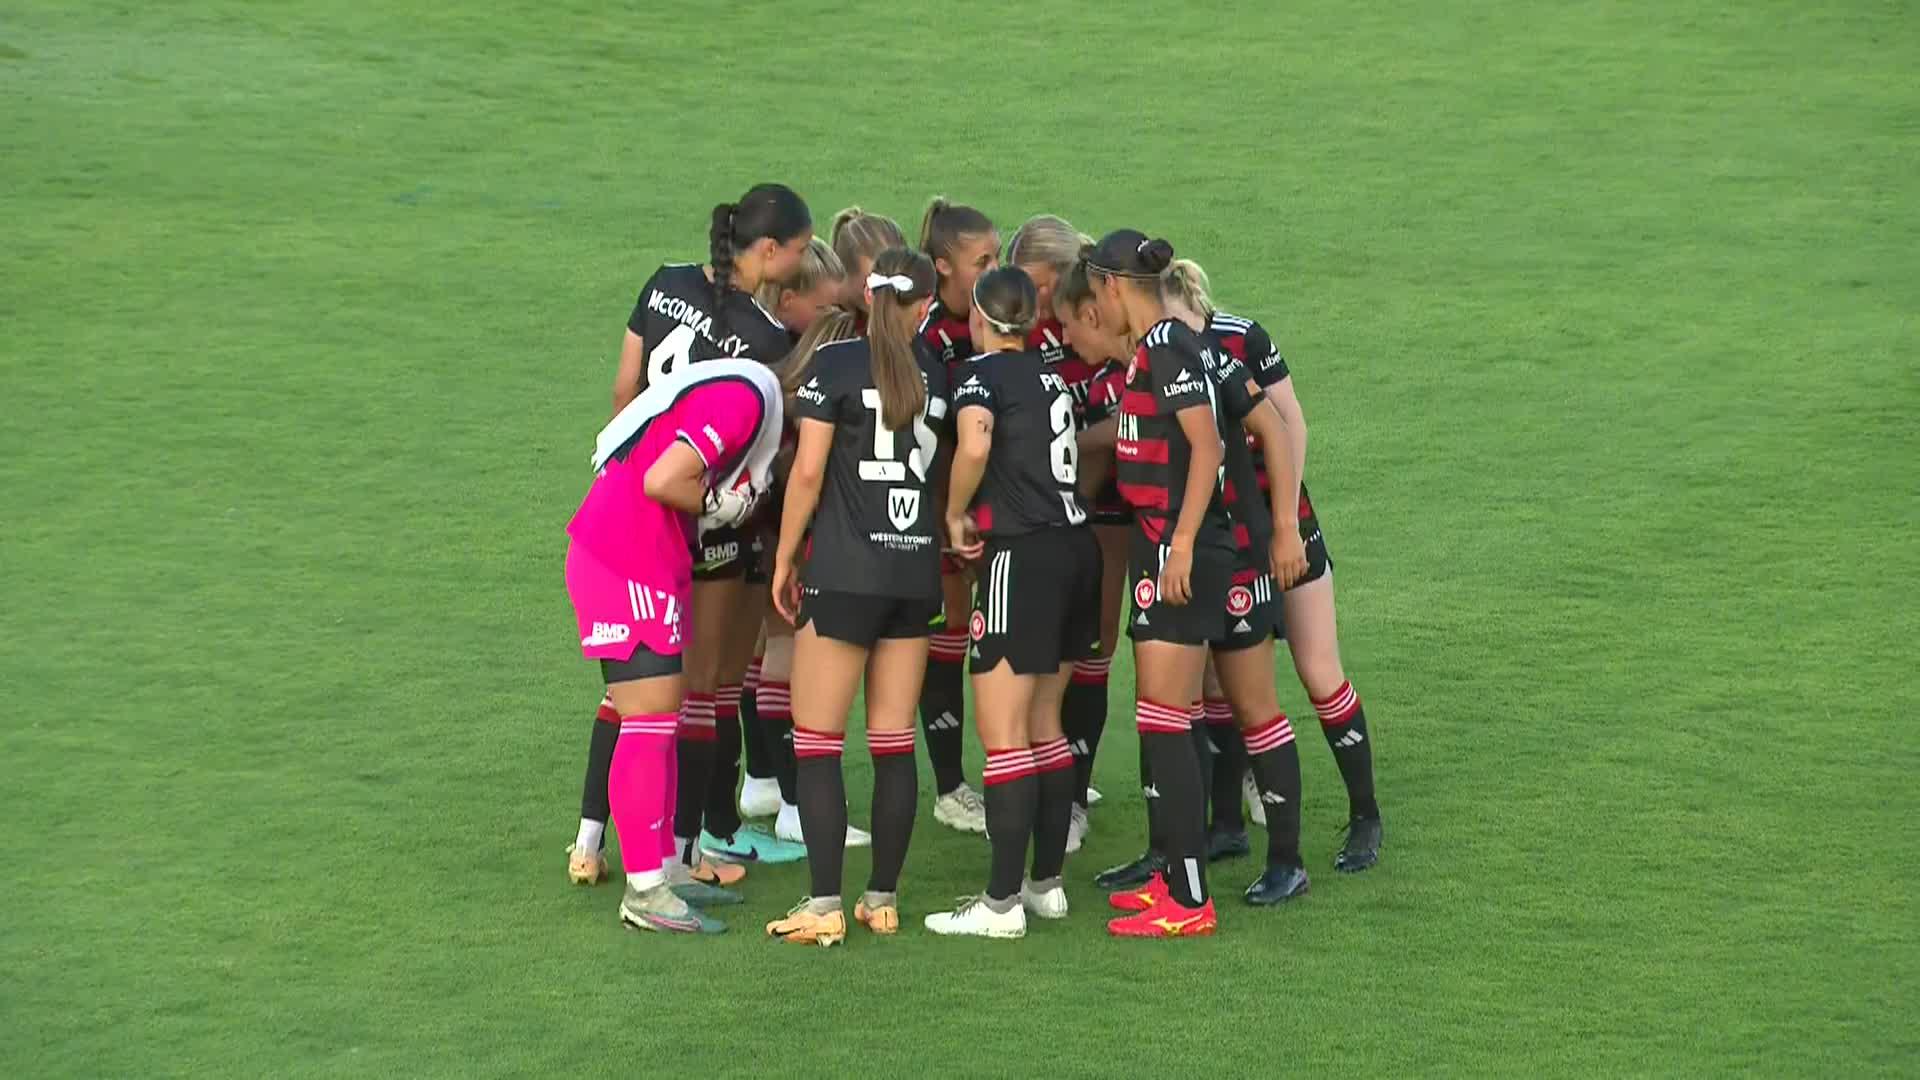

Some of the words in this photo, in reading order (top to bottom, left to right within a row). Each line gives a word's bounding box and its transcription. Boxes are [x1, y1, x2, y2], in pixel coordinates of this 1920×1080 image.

[647, 288, 750, 358] McCOMAKY
[1163, 380, 1204, 398] Liberty
[892, 495, 915, 519] W
[705, 541, 738, 561] BMD
[591, 621, 631, 641] BMD
